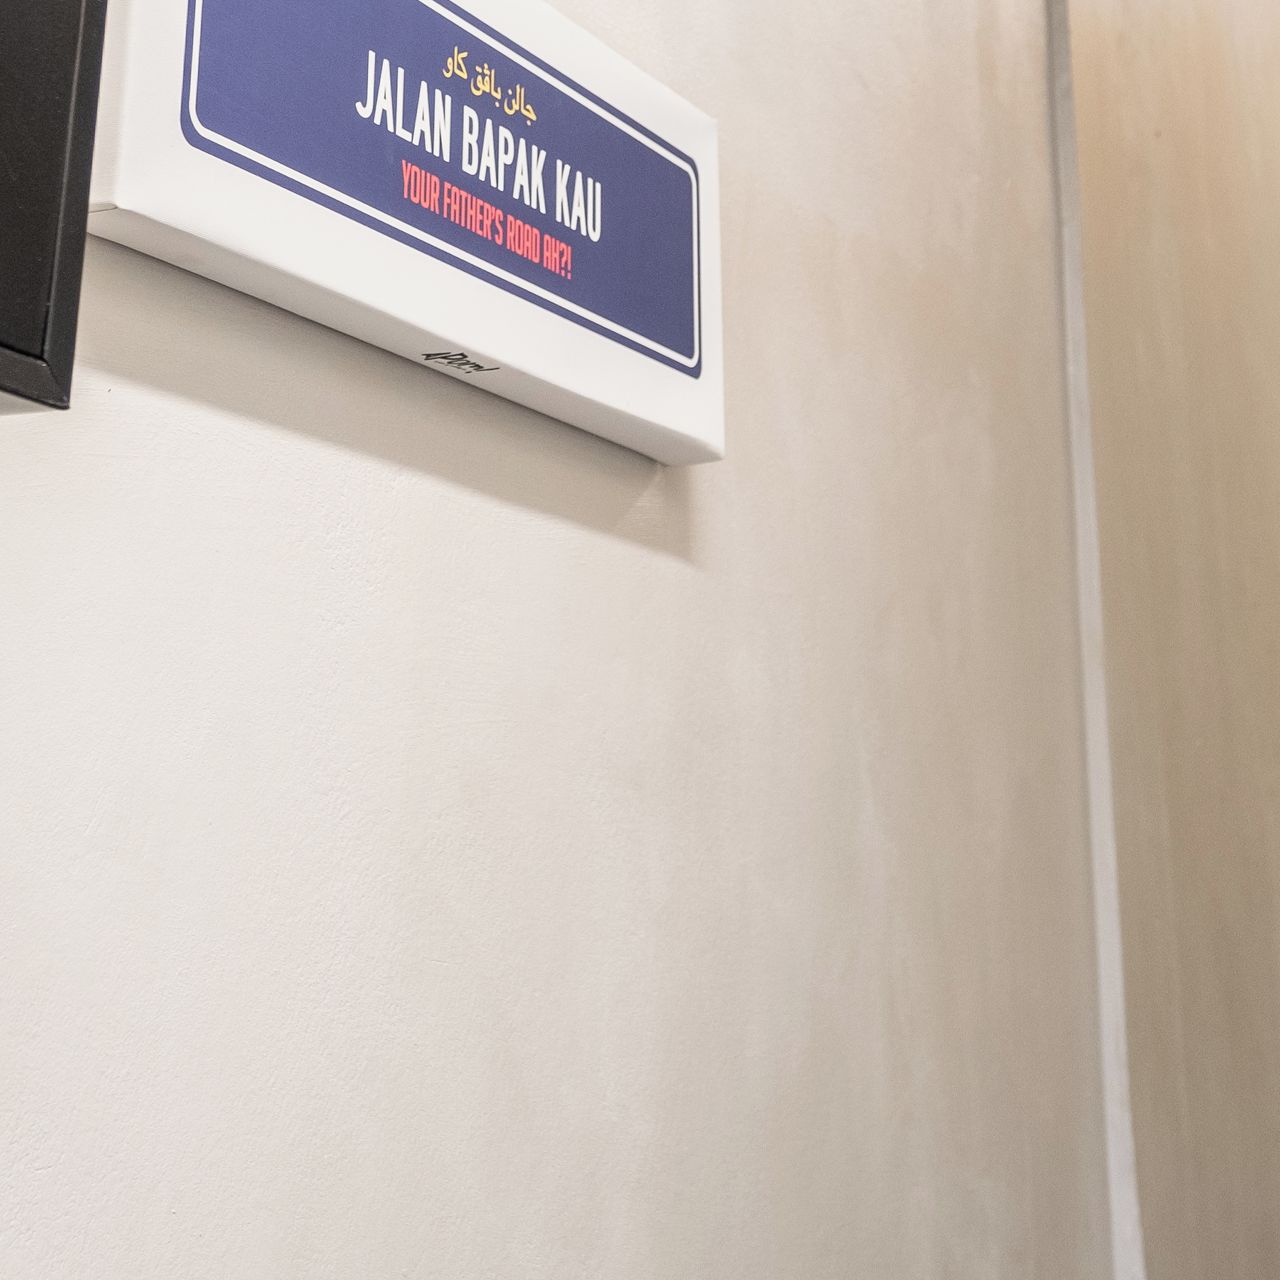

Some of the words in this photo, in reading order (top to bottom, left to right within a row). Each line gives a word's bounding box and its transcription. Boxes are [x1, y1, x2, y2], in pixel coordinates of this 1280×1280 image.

[355, 50, 452, 163] JALAN
[461, 105, 547, 214] BAPAK
[556, 159, 602, 243] KAU
[401, 159, 440, 215] YOUR
[443, 181, 504, 246] FATHER'S
[506, 214, 541, 264] ROAD
[543, 234, 572, 280] AH?!
